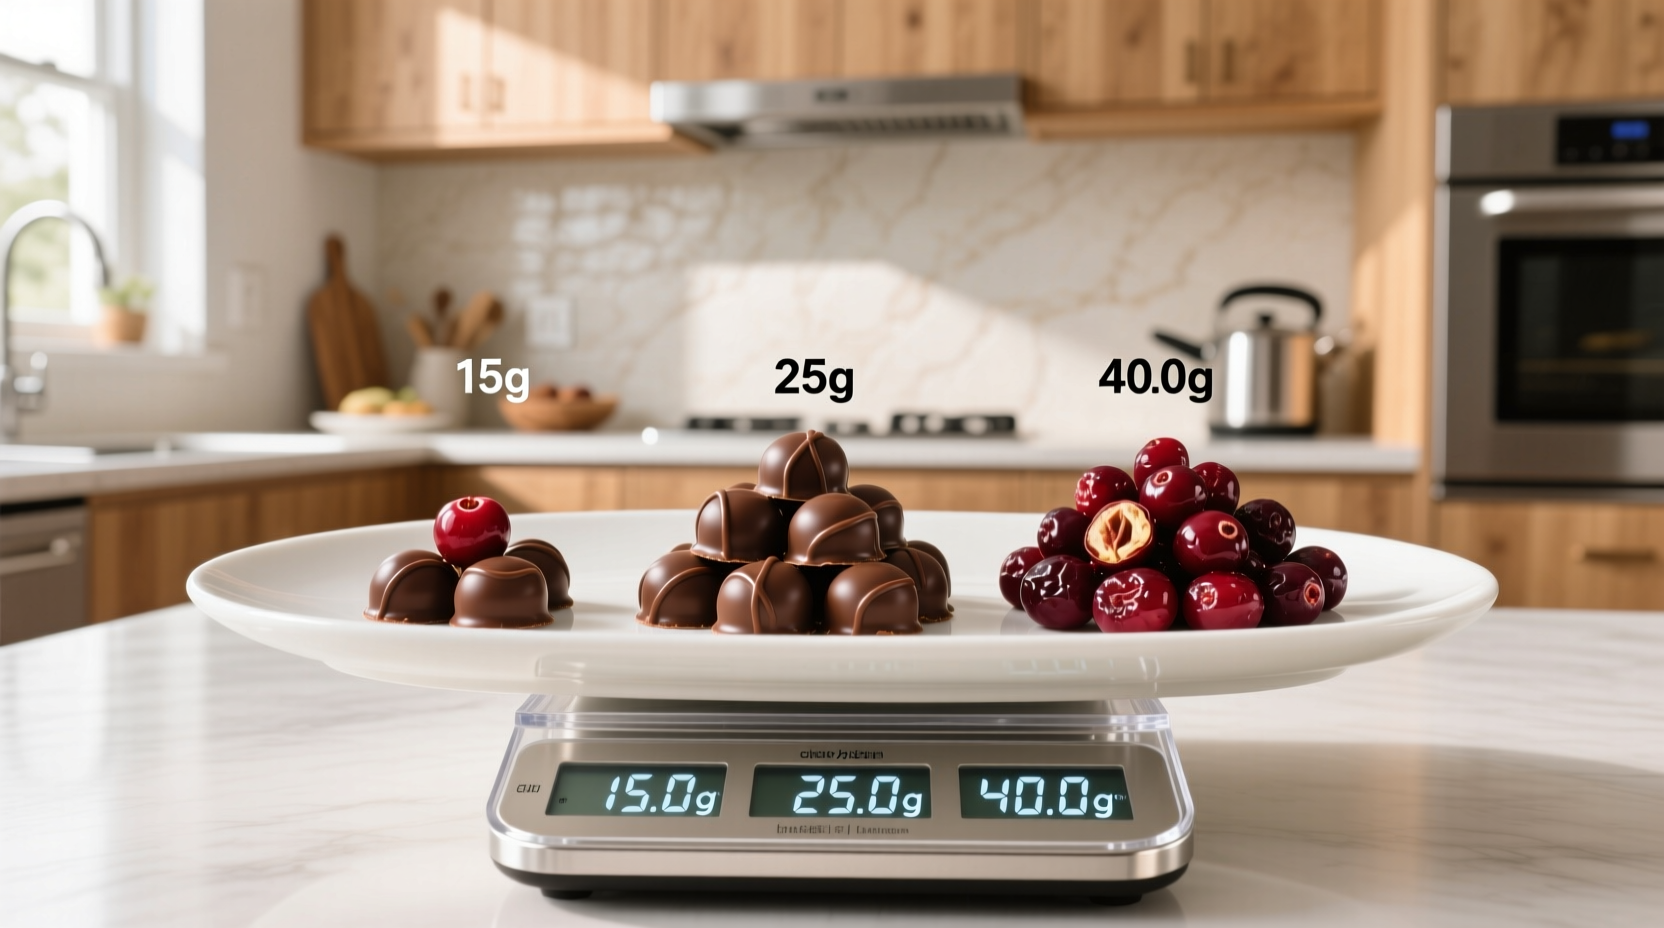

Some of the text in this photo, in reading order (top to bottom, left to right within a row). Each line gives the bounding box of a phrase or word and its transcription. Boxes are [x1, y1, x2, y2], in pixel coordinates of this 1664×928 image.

[605, 773, 718, 817] 15.0g
[792, 775, 923, 818] 25.0g
[979, 776, 1114, 819] 40.0g
